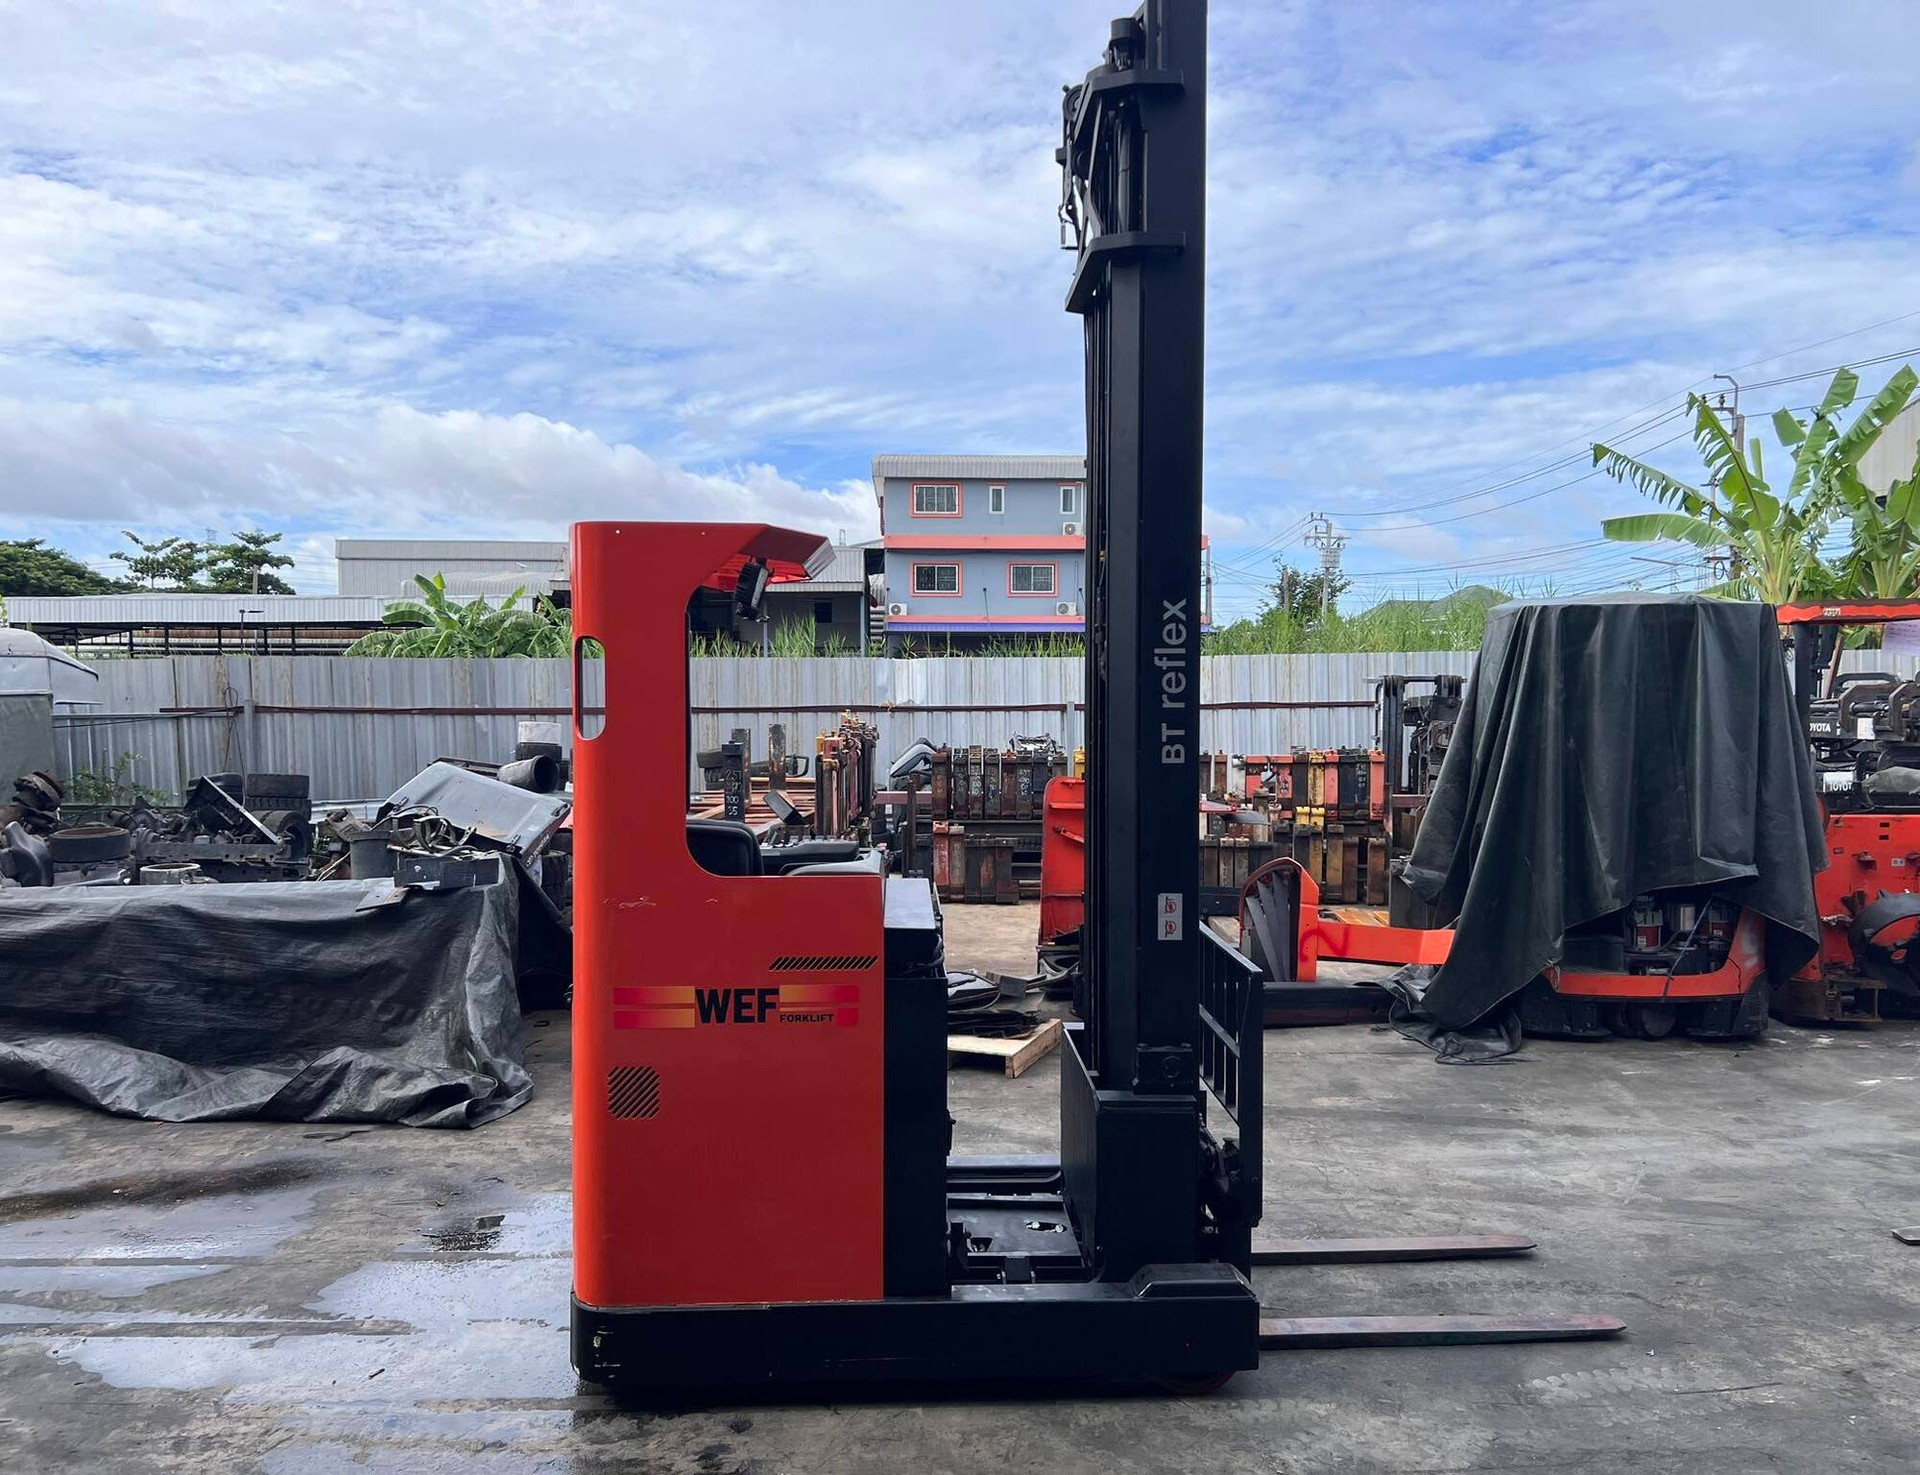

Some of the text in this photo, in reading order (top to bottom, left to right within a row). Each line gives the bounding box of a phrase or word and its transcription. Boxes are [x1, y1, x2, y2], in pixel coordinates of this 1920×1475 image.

[1154, 598, 1187, 764] BT reflex
[1829, 782, 1853, 792] TOYOT
[695, 988, 834, 1024] WEF FORKLIFT
